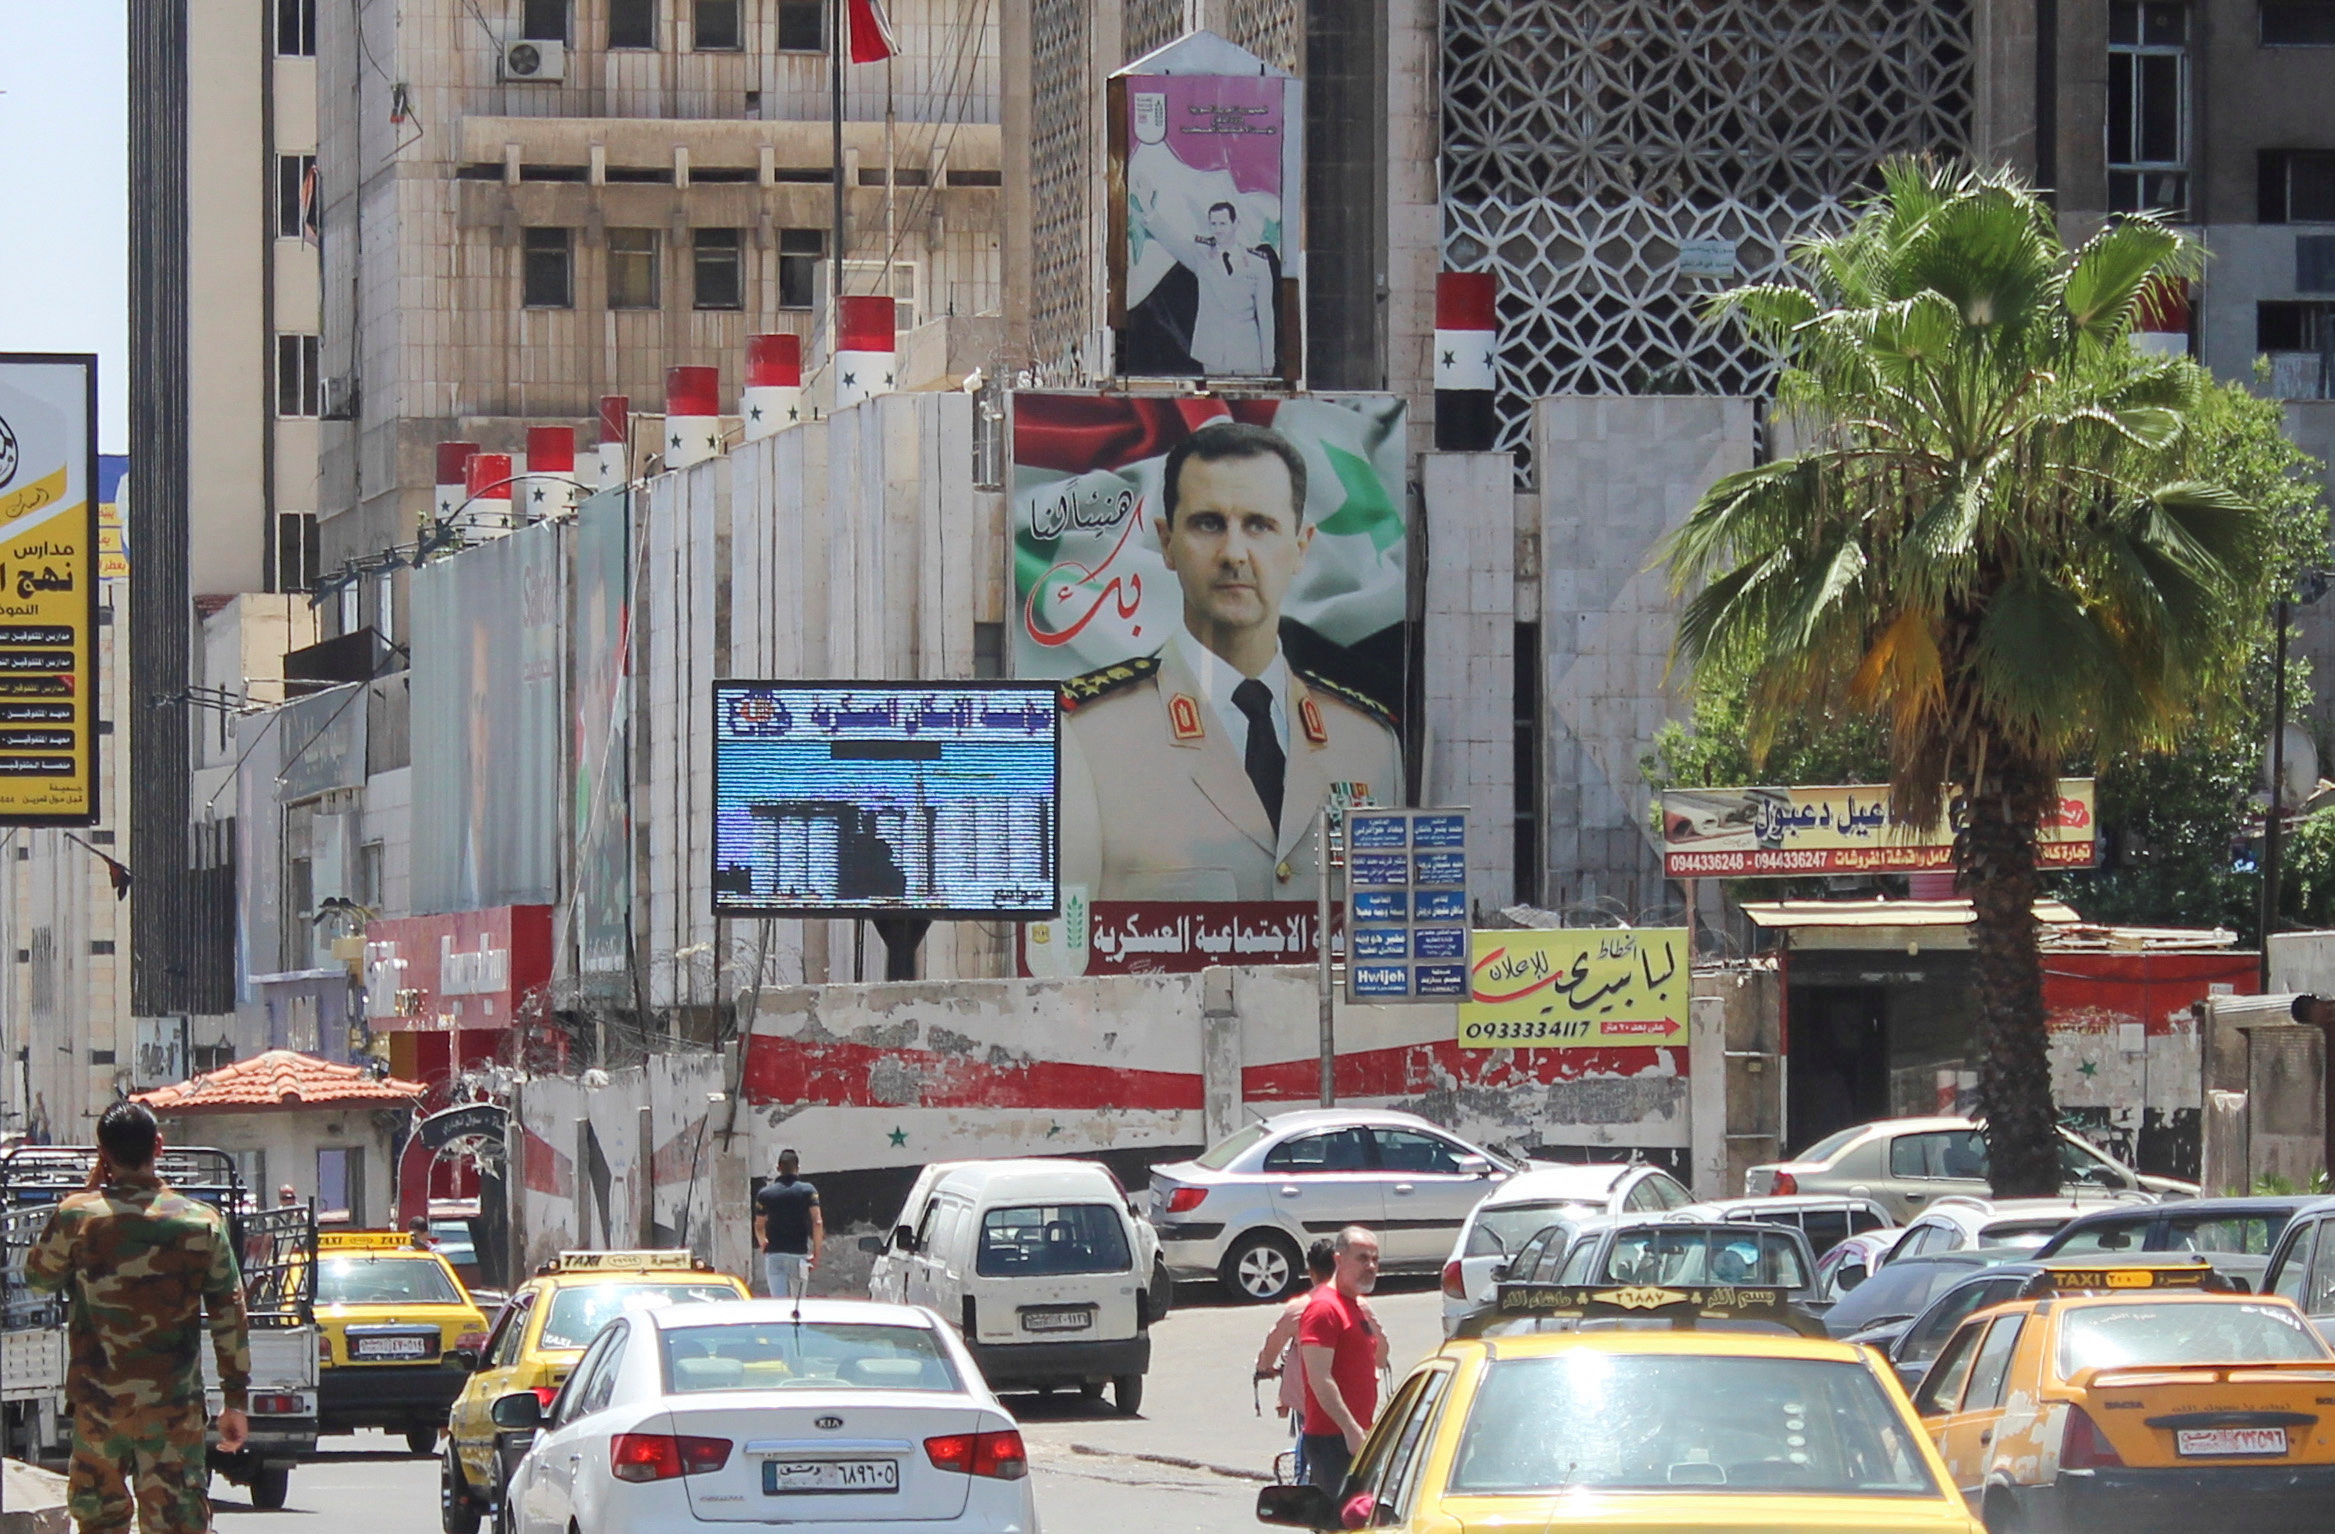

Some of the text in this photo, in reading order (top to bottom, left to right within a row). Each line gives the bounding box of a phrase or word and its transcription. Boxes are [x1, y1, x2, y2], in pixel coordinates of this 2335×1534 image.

[1032, 495, 1068, 540] لنا
[14, 541, 75, 559] مدارس
[17, 562, 73, 599] نهج
[1671, 853, 1744, 871] 0944336248
[1754, 850, 1828, 869] 0944336247
[1093, 913, 1190, 963] العسكرية
[1195, 913, 1307, 962] الاجتماعية
[1358, 969, 1406, 985] Hwijeh
[1466, 1020, 1591, 1039] 0933334117
[380, 1236, 407, 1245] TAXI
[564, 1254, 602, 1267] TAXI
[2052, 1273, 2100, 1286] TAXI
[1707, 1287, 1736, 1309] الله
[818, 1419, 840, 1428] KIA
[779, 1464, 895, 1485] دمشق ٦٨٩٦٠٥
